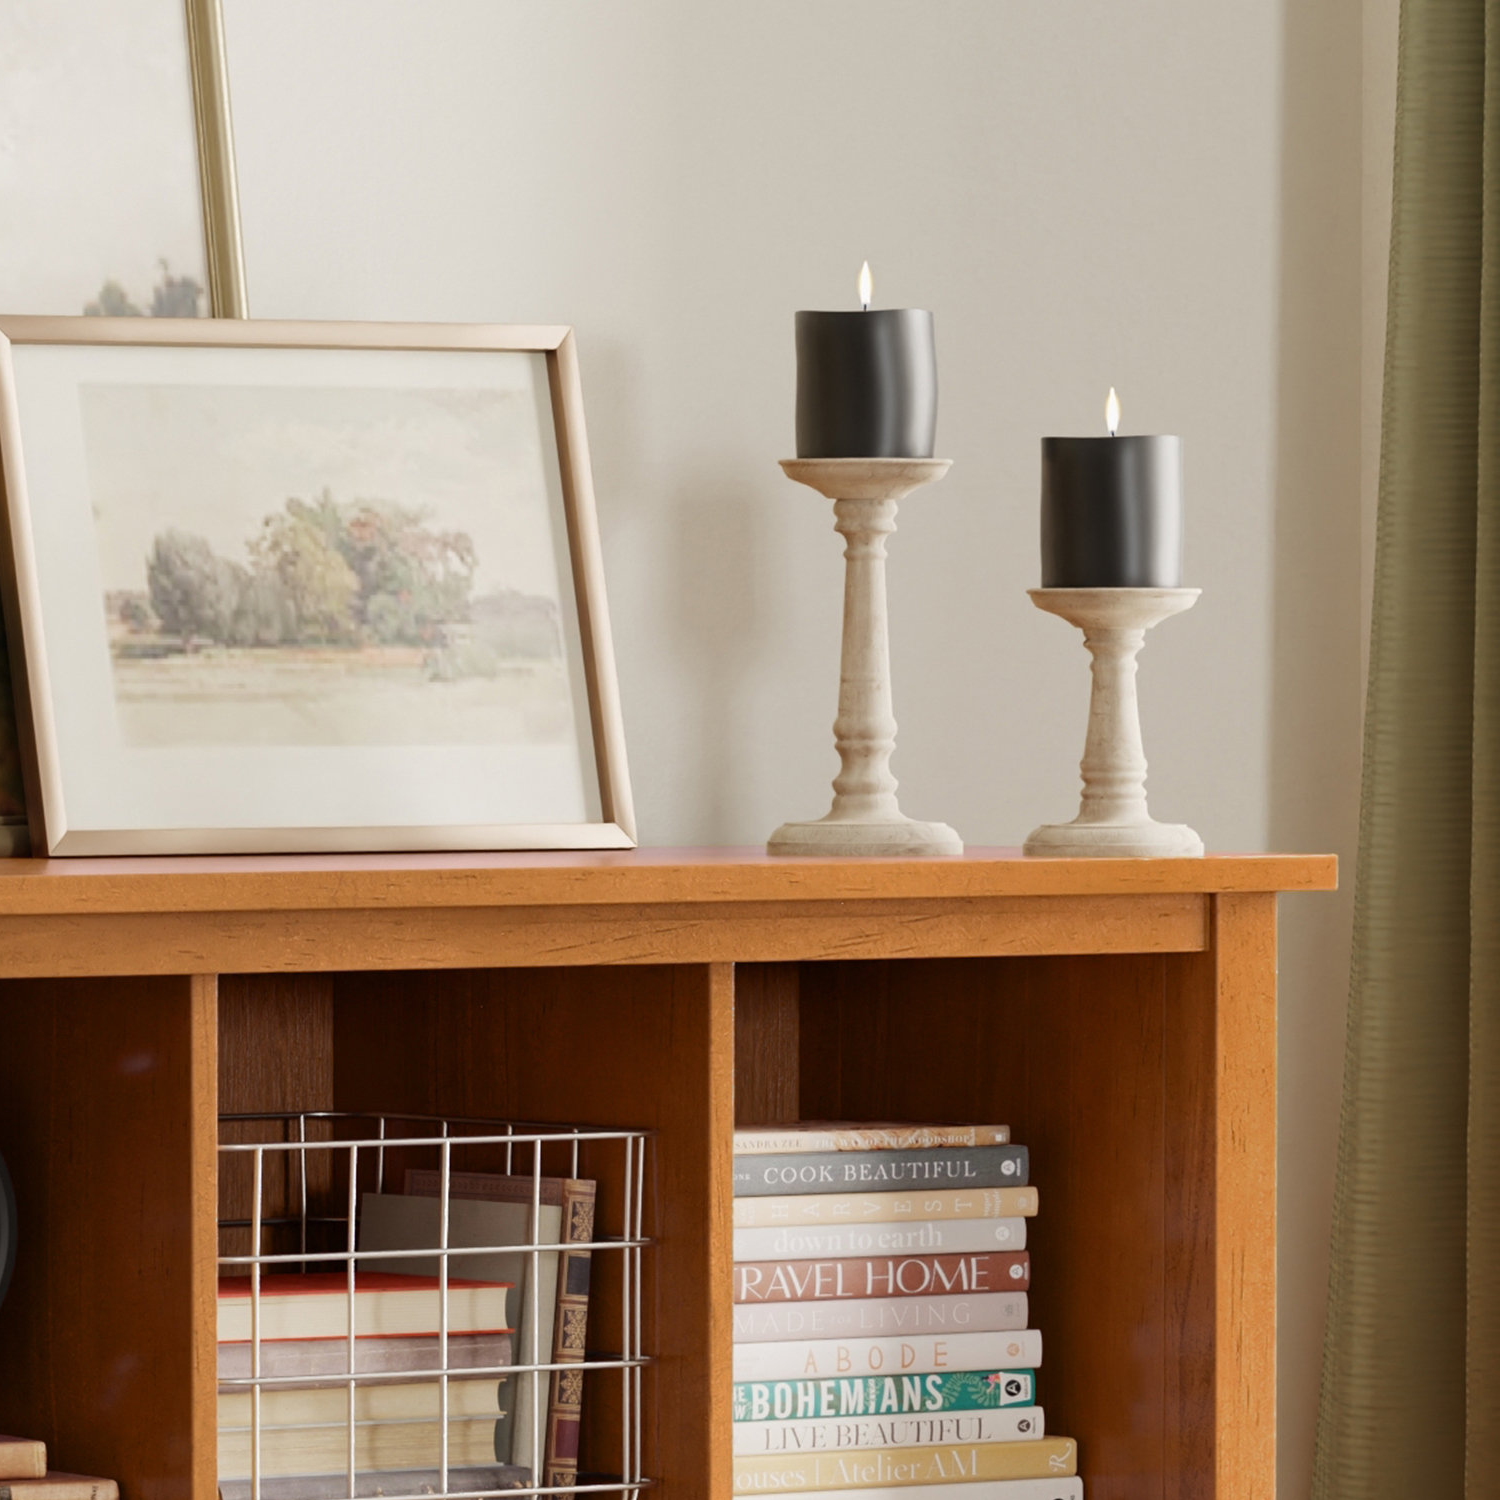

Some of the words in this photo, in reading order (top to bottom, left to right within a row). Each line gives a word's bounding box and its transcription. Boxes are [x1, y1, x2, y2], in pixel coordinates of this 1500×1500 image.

[763, 1165, 834, 1185] COOK
[844, 1160, 977, 1181] BEAUTIFUL
[772, 1197, 973, 1219] HARVEST
[773, 1229, 850, 1254] down
[852, 1230, 875, 1251] to
[877, 1223, 942, 1249] earth
[734, 1263, 853, 1300] RAVEL
[866, 1256, 990, 1295] HOME
[734, 1309, 825, 1335] MADE
[859, 1302, 973, 1330] LIVING
[804, 1341, 949, 1374] ABODE
[751, 1373, 944, 1420] BOHEMIANS
[764, 1426, 828, 1451] LIVE
[836, 1416, 993, 1449] BEAUTIFUL
[829, 1454, 921, 1486] Atelier
[926, 1449, 979, 1478] AM
